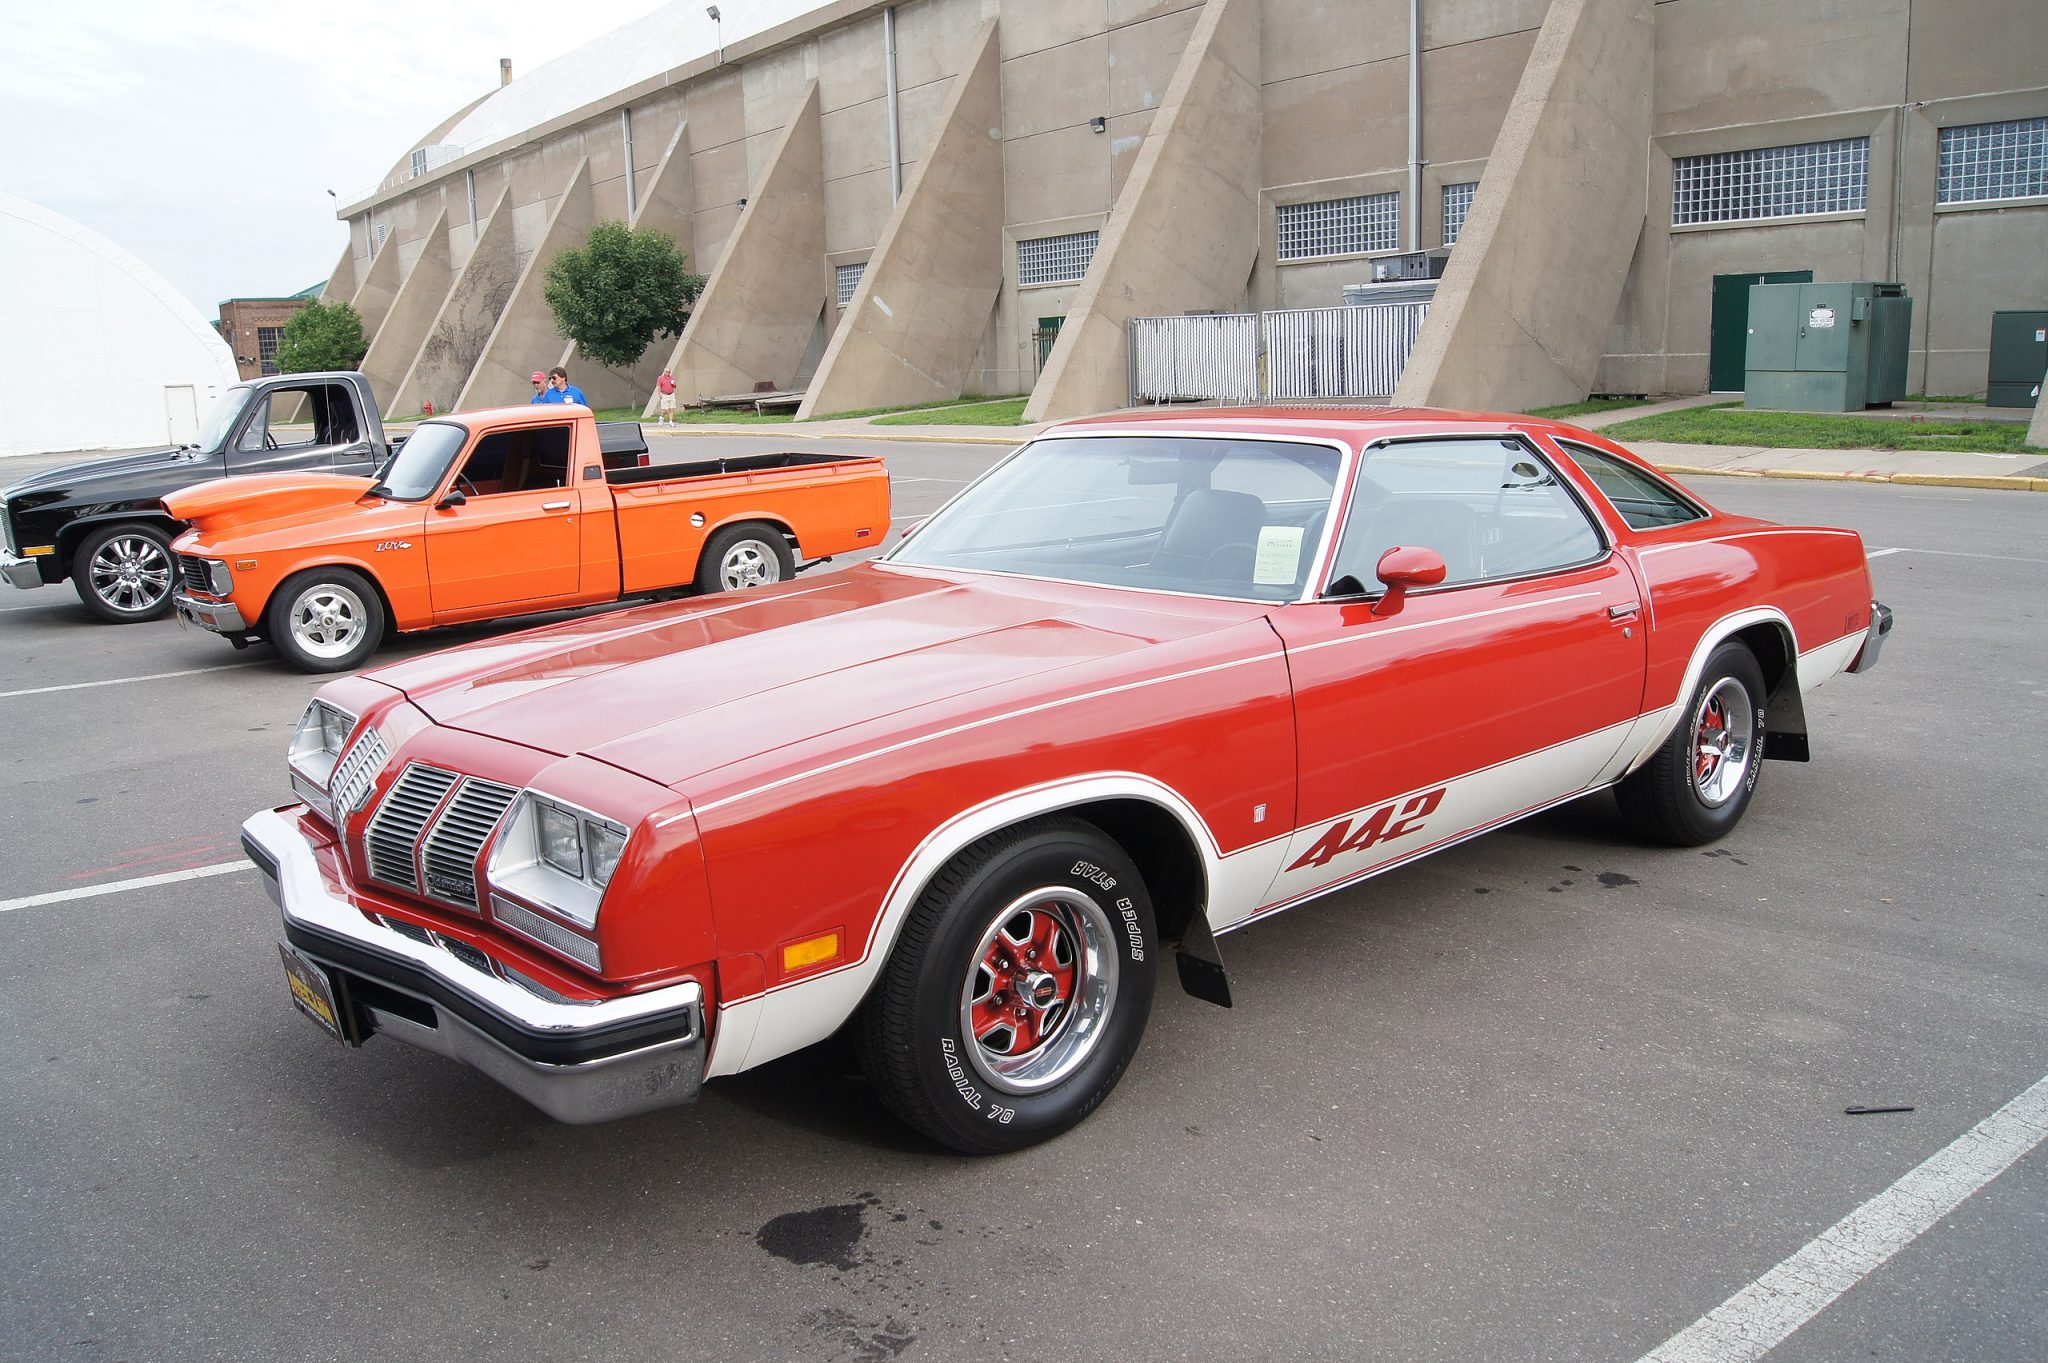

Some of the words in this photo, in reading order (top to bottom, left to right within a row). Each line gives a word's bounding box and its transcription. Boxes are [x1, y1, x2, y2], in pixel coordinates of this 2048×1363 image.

[375, 541, 404, 552] LUV
[1746, 736, 1764, 791] RADIAL
[1757, 708, 1765, 729] 70
[1284, 787, 1447, 873] 442
[1071, 861, 1117, 891] STAR
[1116, 898, 1145, 961] SUPER
[942, 1038, 982, 1110] RADIAL
[987, 1104, 1015, 1124] 70
